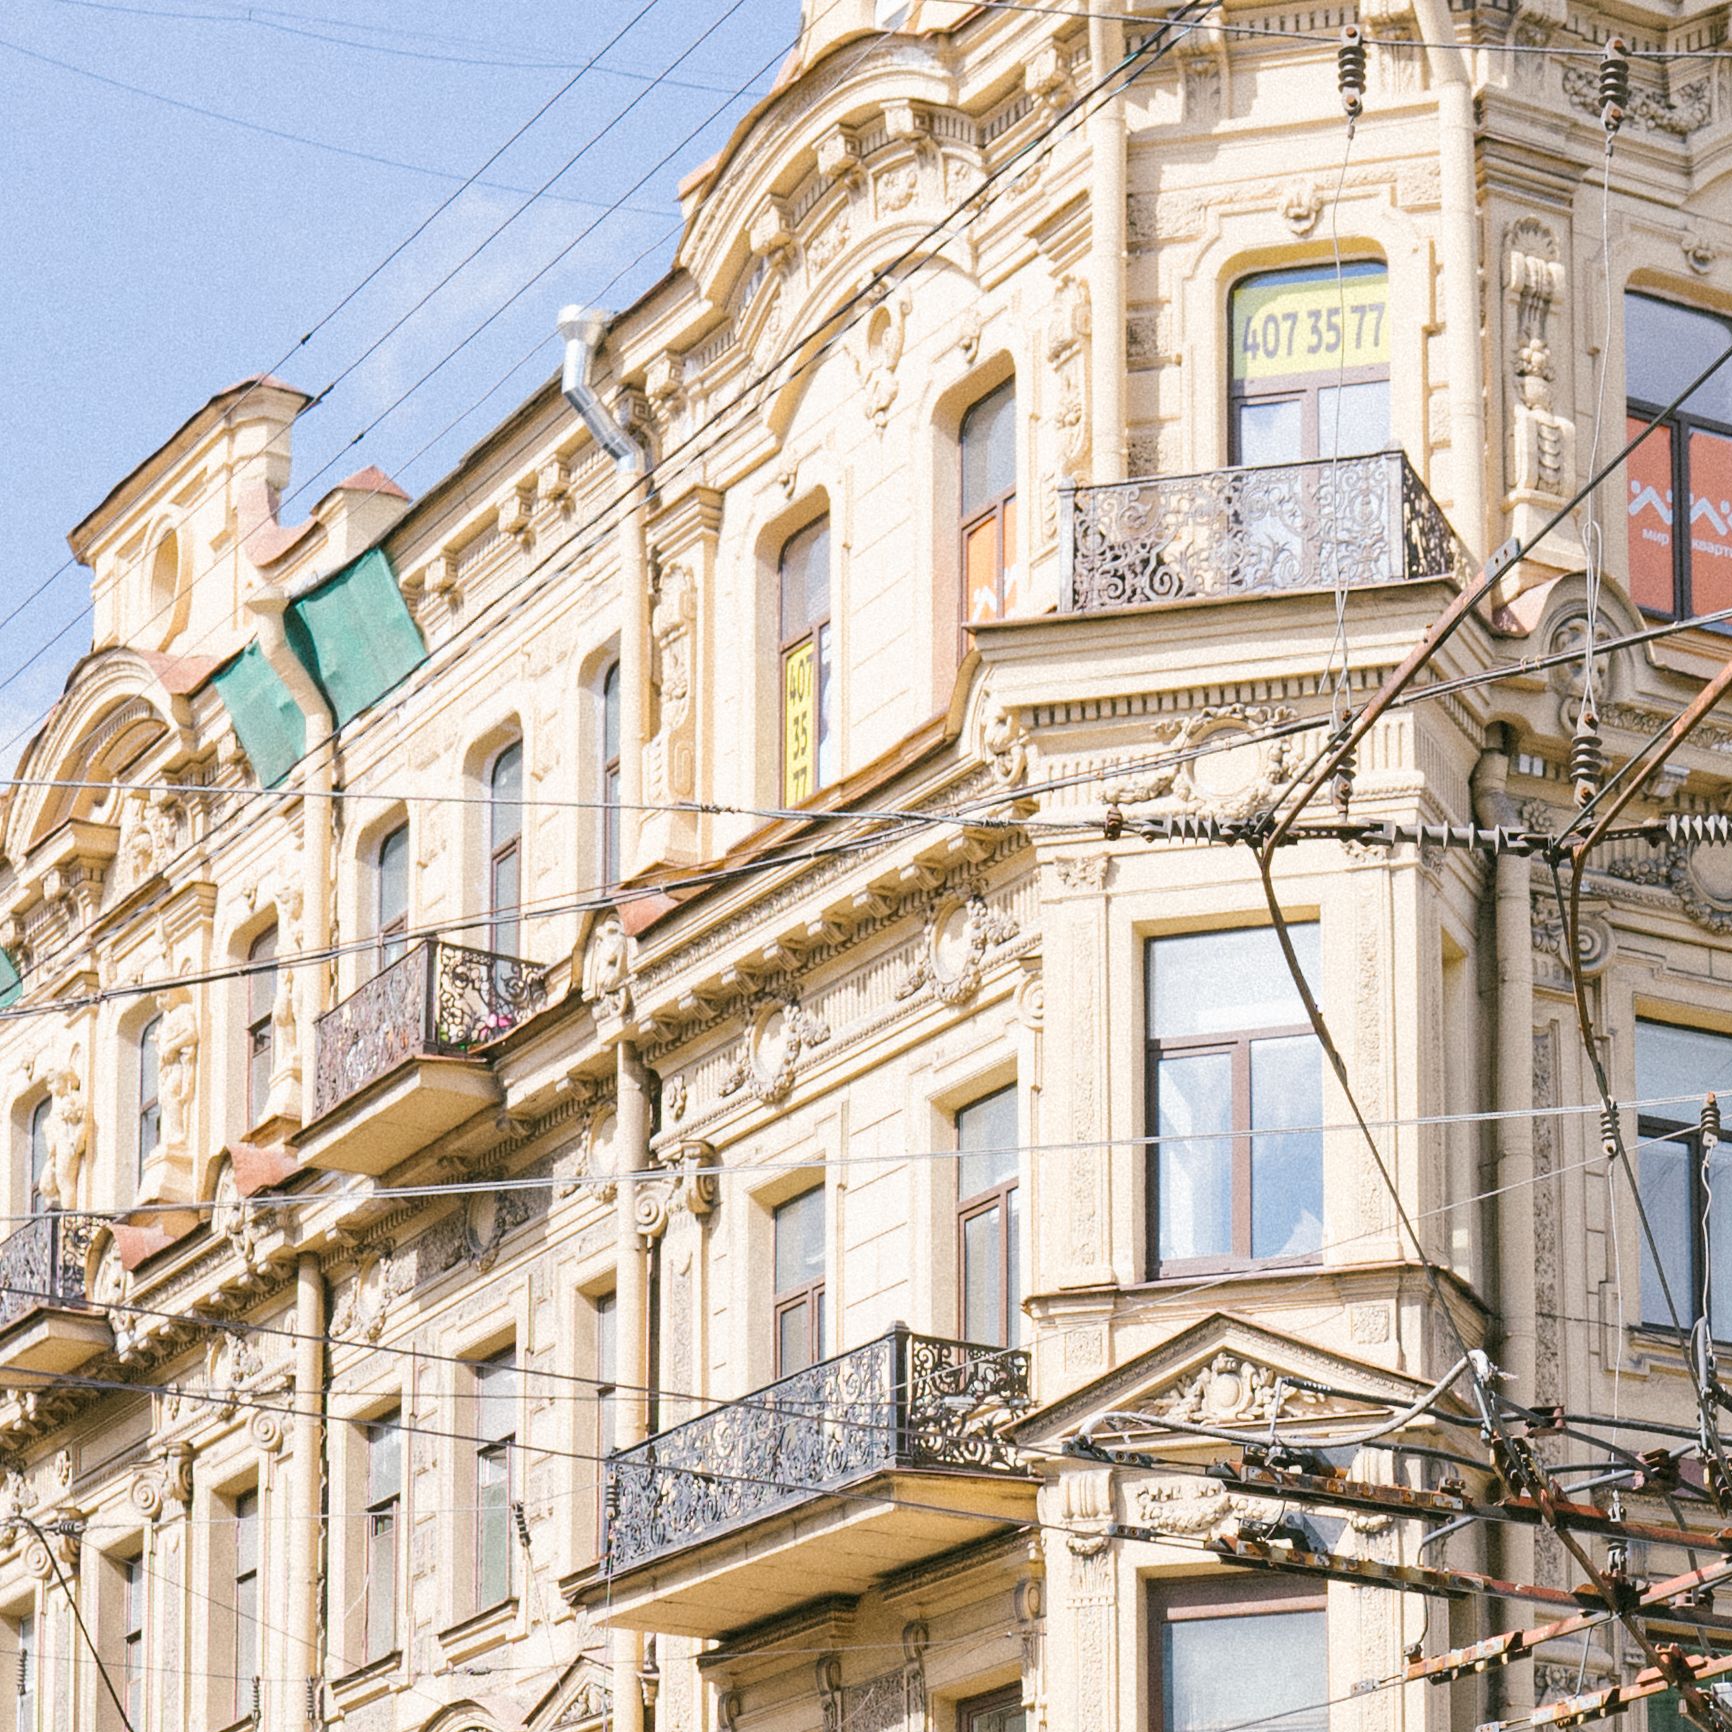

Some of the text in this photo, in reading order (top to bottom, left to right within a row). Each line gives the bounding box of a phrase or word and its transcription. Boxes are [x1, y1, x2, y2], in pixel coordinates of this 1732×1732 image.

[1242, 301, 1386, 360] 407 35 77
[789, 653, 814, 706] 407
[792, 711, 807, 760] 35
